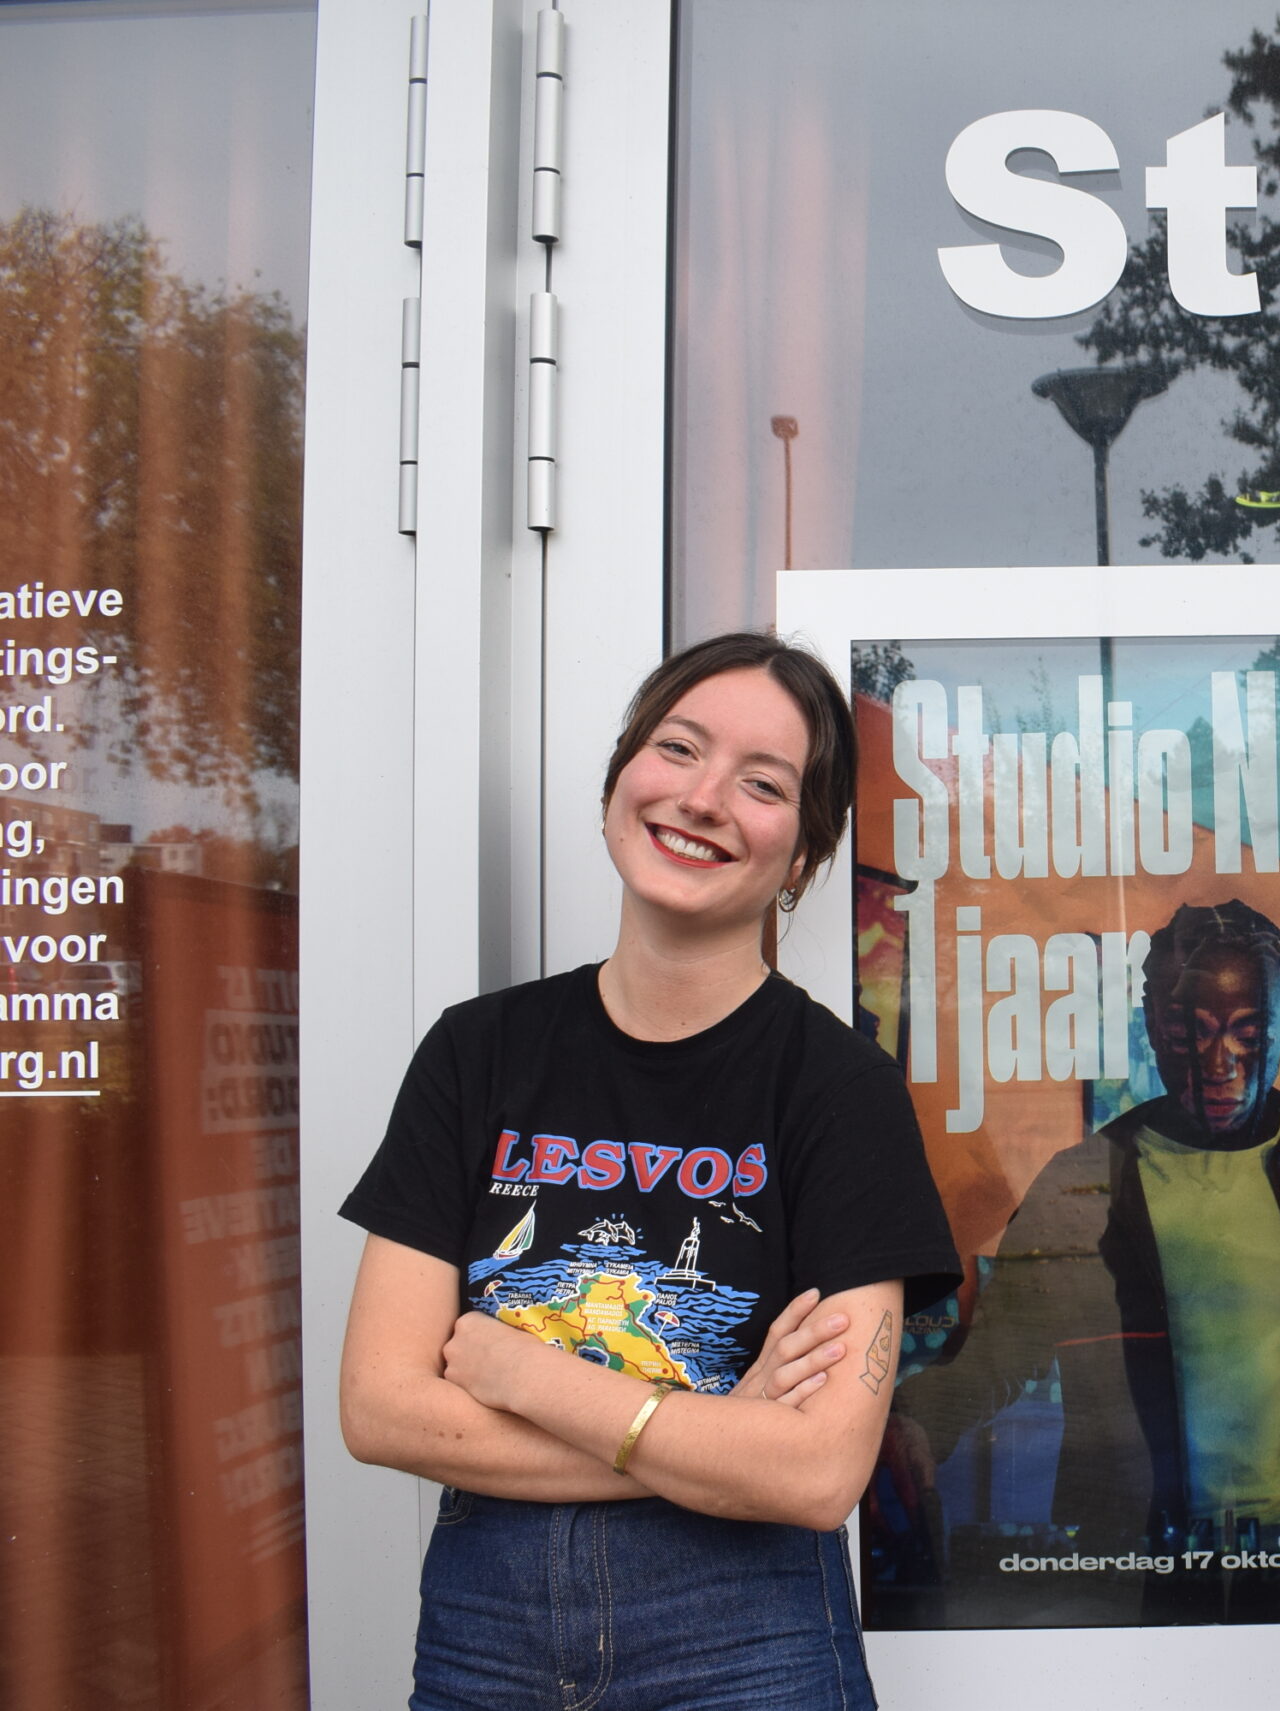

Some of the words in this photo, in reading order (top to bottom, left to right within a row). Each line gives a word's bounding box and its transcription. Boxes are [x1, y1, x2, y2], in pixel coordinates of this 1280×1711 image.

[0, 640, 117, 685] ings-
[892, 674, 1194, 881] Studio
[1, 869, 124, 914] ingen
[3, 933, 107, 963] voor
[893, 877, 938, 1084] 1
[945, 905, 1152, 1134] jaar
[491, 1128, 768, 1200] LESVOS
[999, 1552, 1174, 1575] donderdag
[1181, 1550, 1213, 1571] 17
